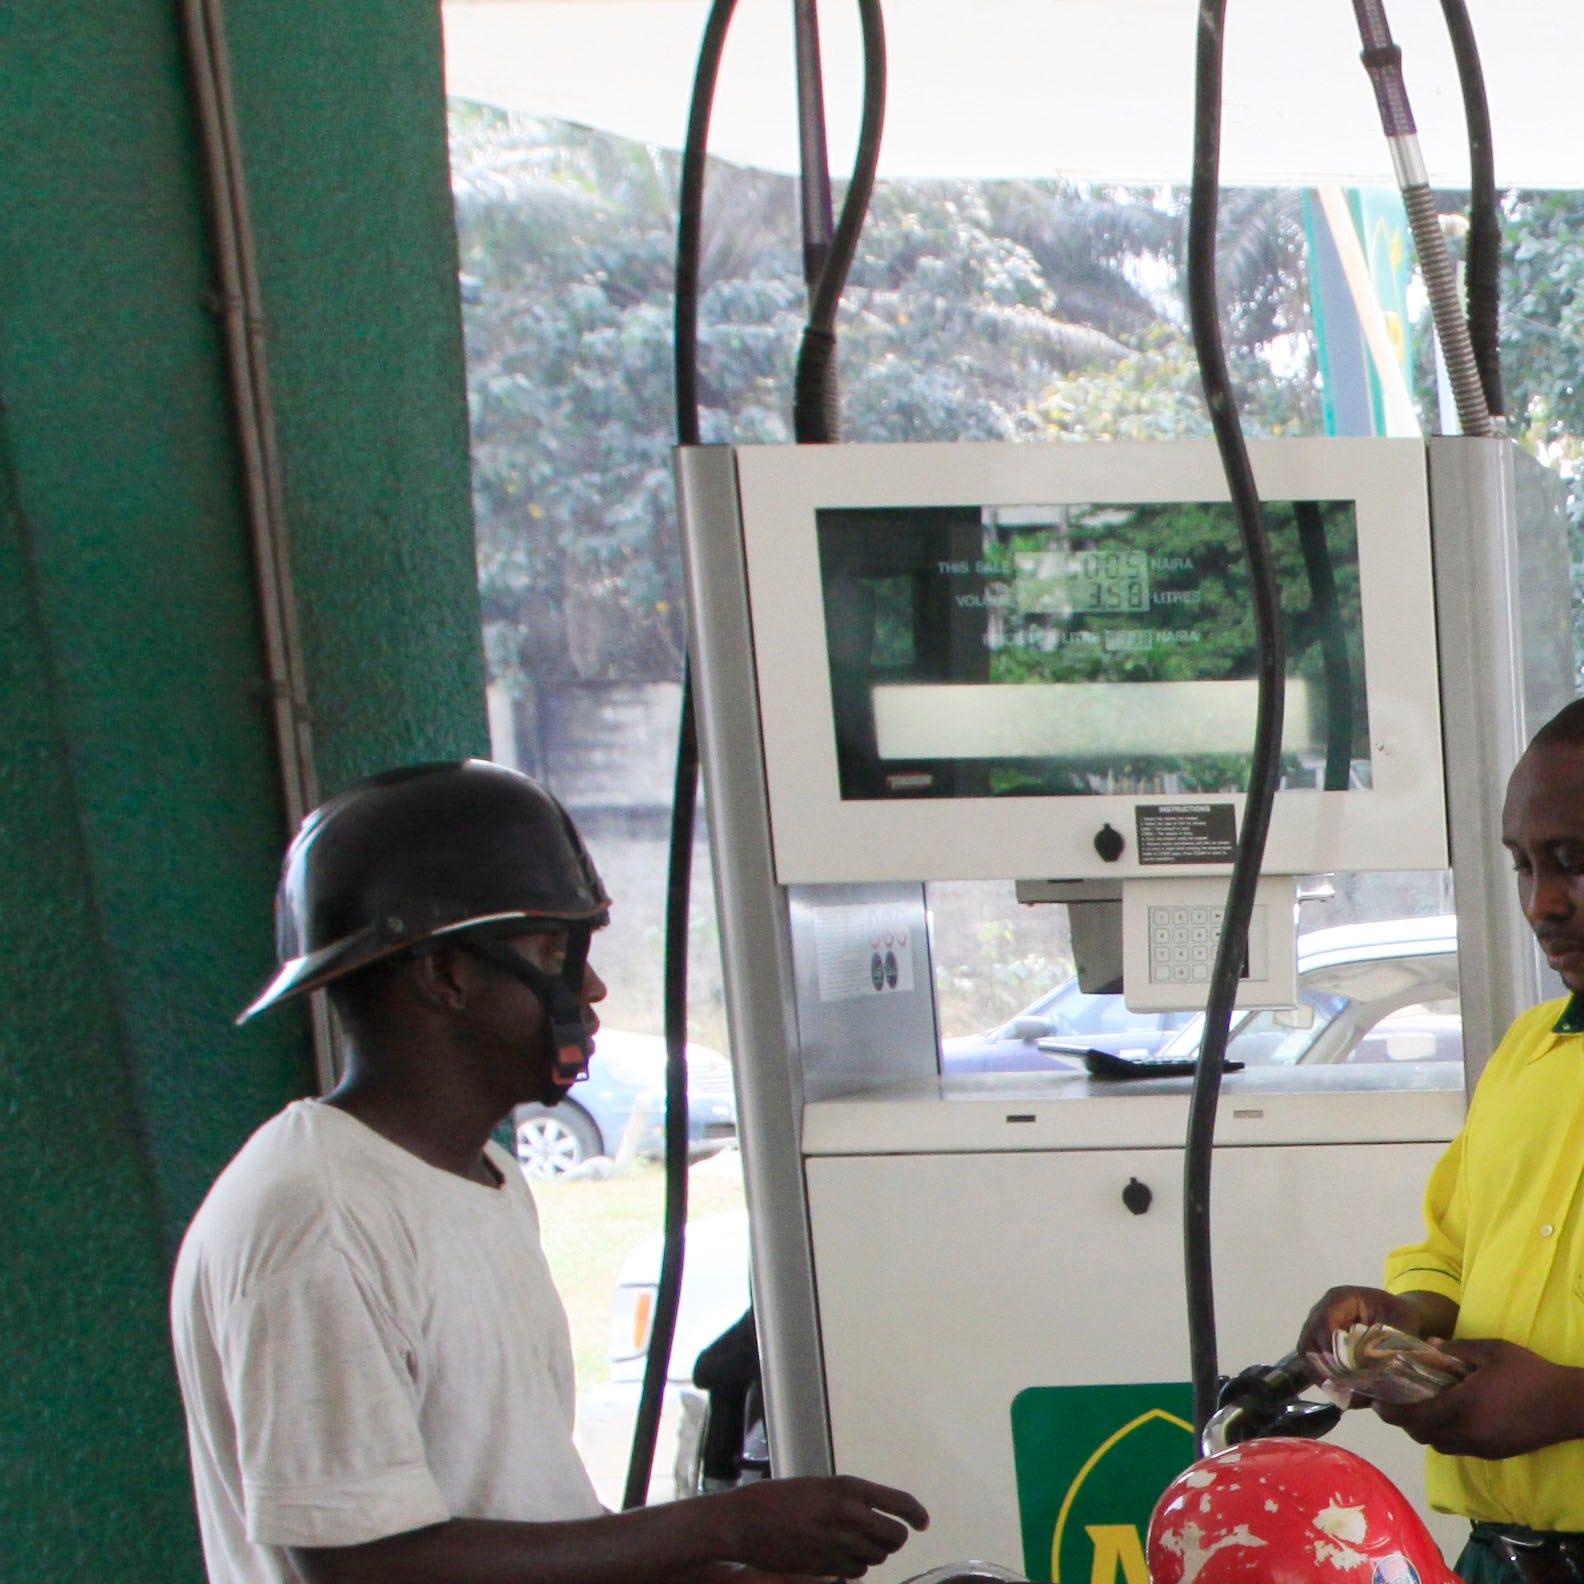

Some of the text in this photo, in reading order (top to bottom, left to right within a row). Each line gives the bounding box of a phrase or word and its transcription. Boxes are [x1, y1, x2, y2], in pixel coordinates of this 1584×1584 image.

[938, 561, 970, 575] THIS
[1151, 557, 1194, 571] NAIRA
[1152, 591, 1200, 604] LITRES
[1156, 631, 1199, 643] NAIRA
